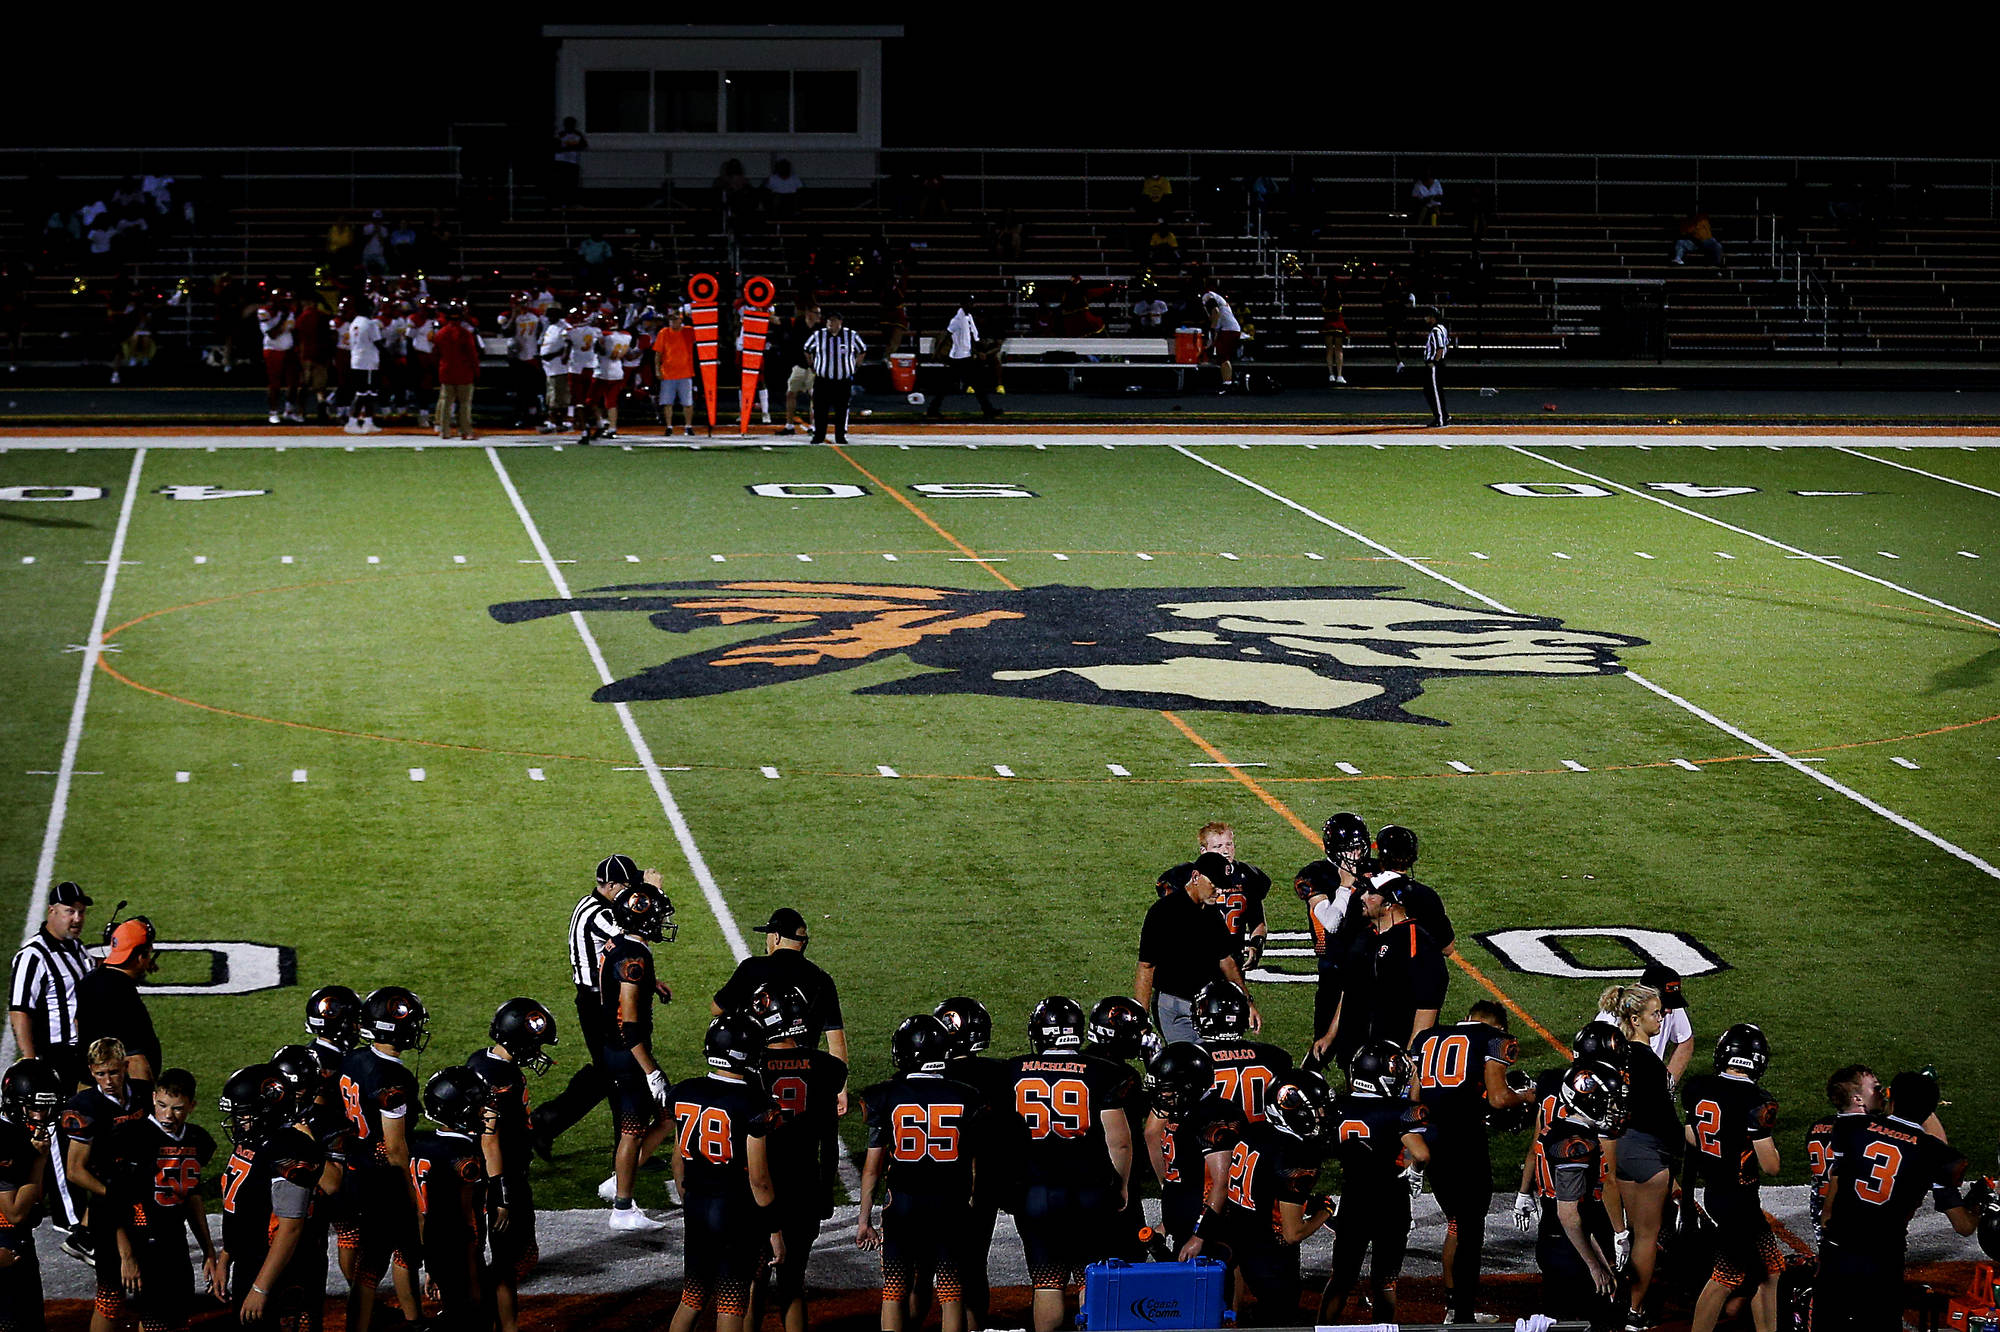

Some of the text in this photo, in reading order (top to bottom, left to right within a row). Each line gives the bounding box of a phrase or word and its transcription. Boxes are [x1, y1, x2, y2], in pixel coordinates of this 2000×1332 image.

[767, 1060, 811, 1070] GUZIAK
[1211, 1049, 1256, 1062] CHALCO
[1420, 1035, 1470, 1089] 10
[771, 1077, 808, 1128] 9
[1014, 1078, 1091, 1140] 69
[1212, 1065, 1274, 1124] 70
[674, 1102, 734, 1165] 78
[892, 1103, 964, 1162] 65
[1695, 1099, 1722, 1159] 2
[1866, 1121, 1918, 1145] ZAMORA
[221, 1153, 253, 1214] 7
[1228, 1141, 1260, 1211] 21
[1854, 1140, 1903, 1206] 3
[1147, 1299, 1178, 1309] Coach
